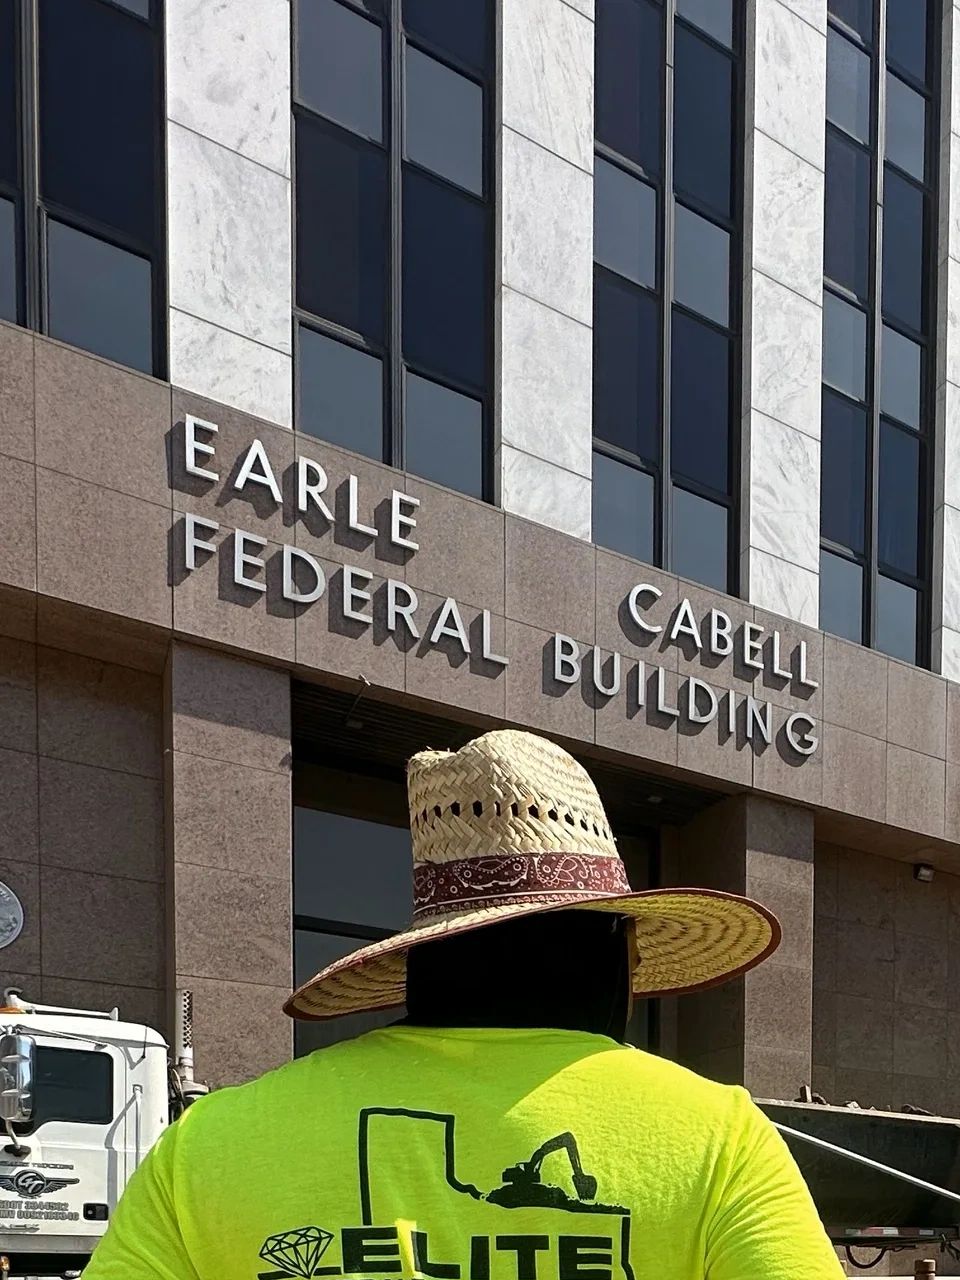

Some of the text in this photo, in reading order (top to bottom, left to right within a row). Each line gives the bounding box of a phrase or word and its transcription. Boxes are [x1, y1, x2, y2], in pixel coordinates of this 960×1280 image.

[184, 413, 820, 690] EARLE CABELL
[184, 512, 819, 756] FEDERAL BUILDING
